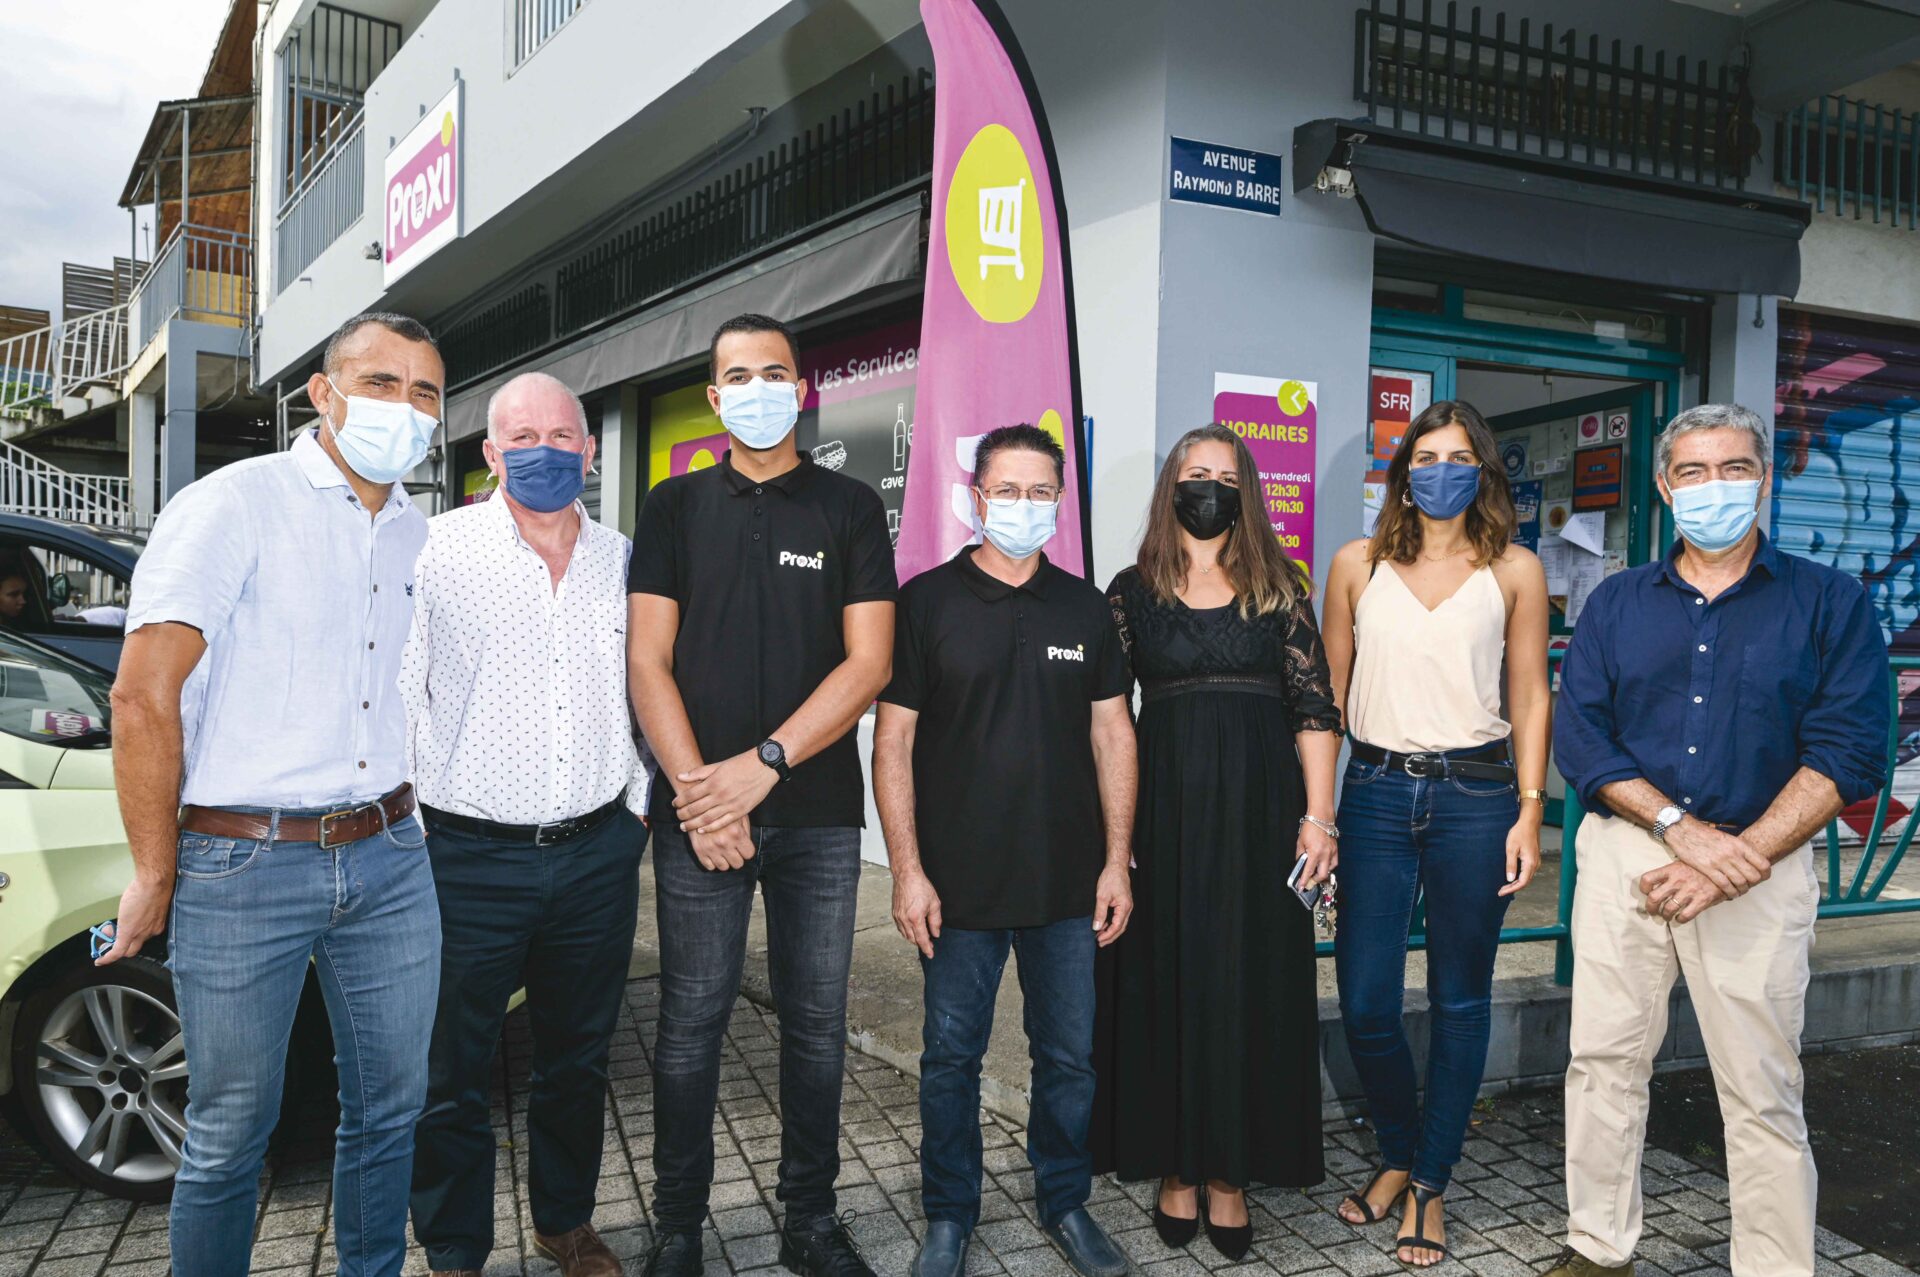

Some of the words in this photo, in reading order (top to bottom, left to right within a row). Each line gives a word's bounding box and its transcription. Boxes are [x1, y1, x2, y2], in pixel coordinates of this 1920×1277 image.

[1203, 151, 1256, 174] AVENUE
[389, 111, 454, 249] Proxi
[1236, 180, 1280, 205] BARRE
[815, 368, 842, 392] Les
[1380, 392, 1410, 411] SFR
[881, 475, 904, 489] cave
[1271, 472, 1311, 483] vendredi
[1265, 483, 1300, 498] 12h30
[1269, 499, 1304, 514] 19h30
[779, 551, 824, 570] Proxi
[1047, 644, 1084, 662] Proxi
